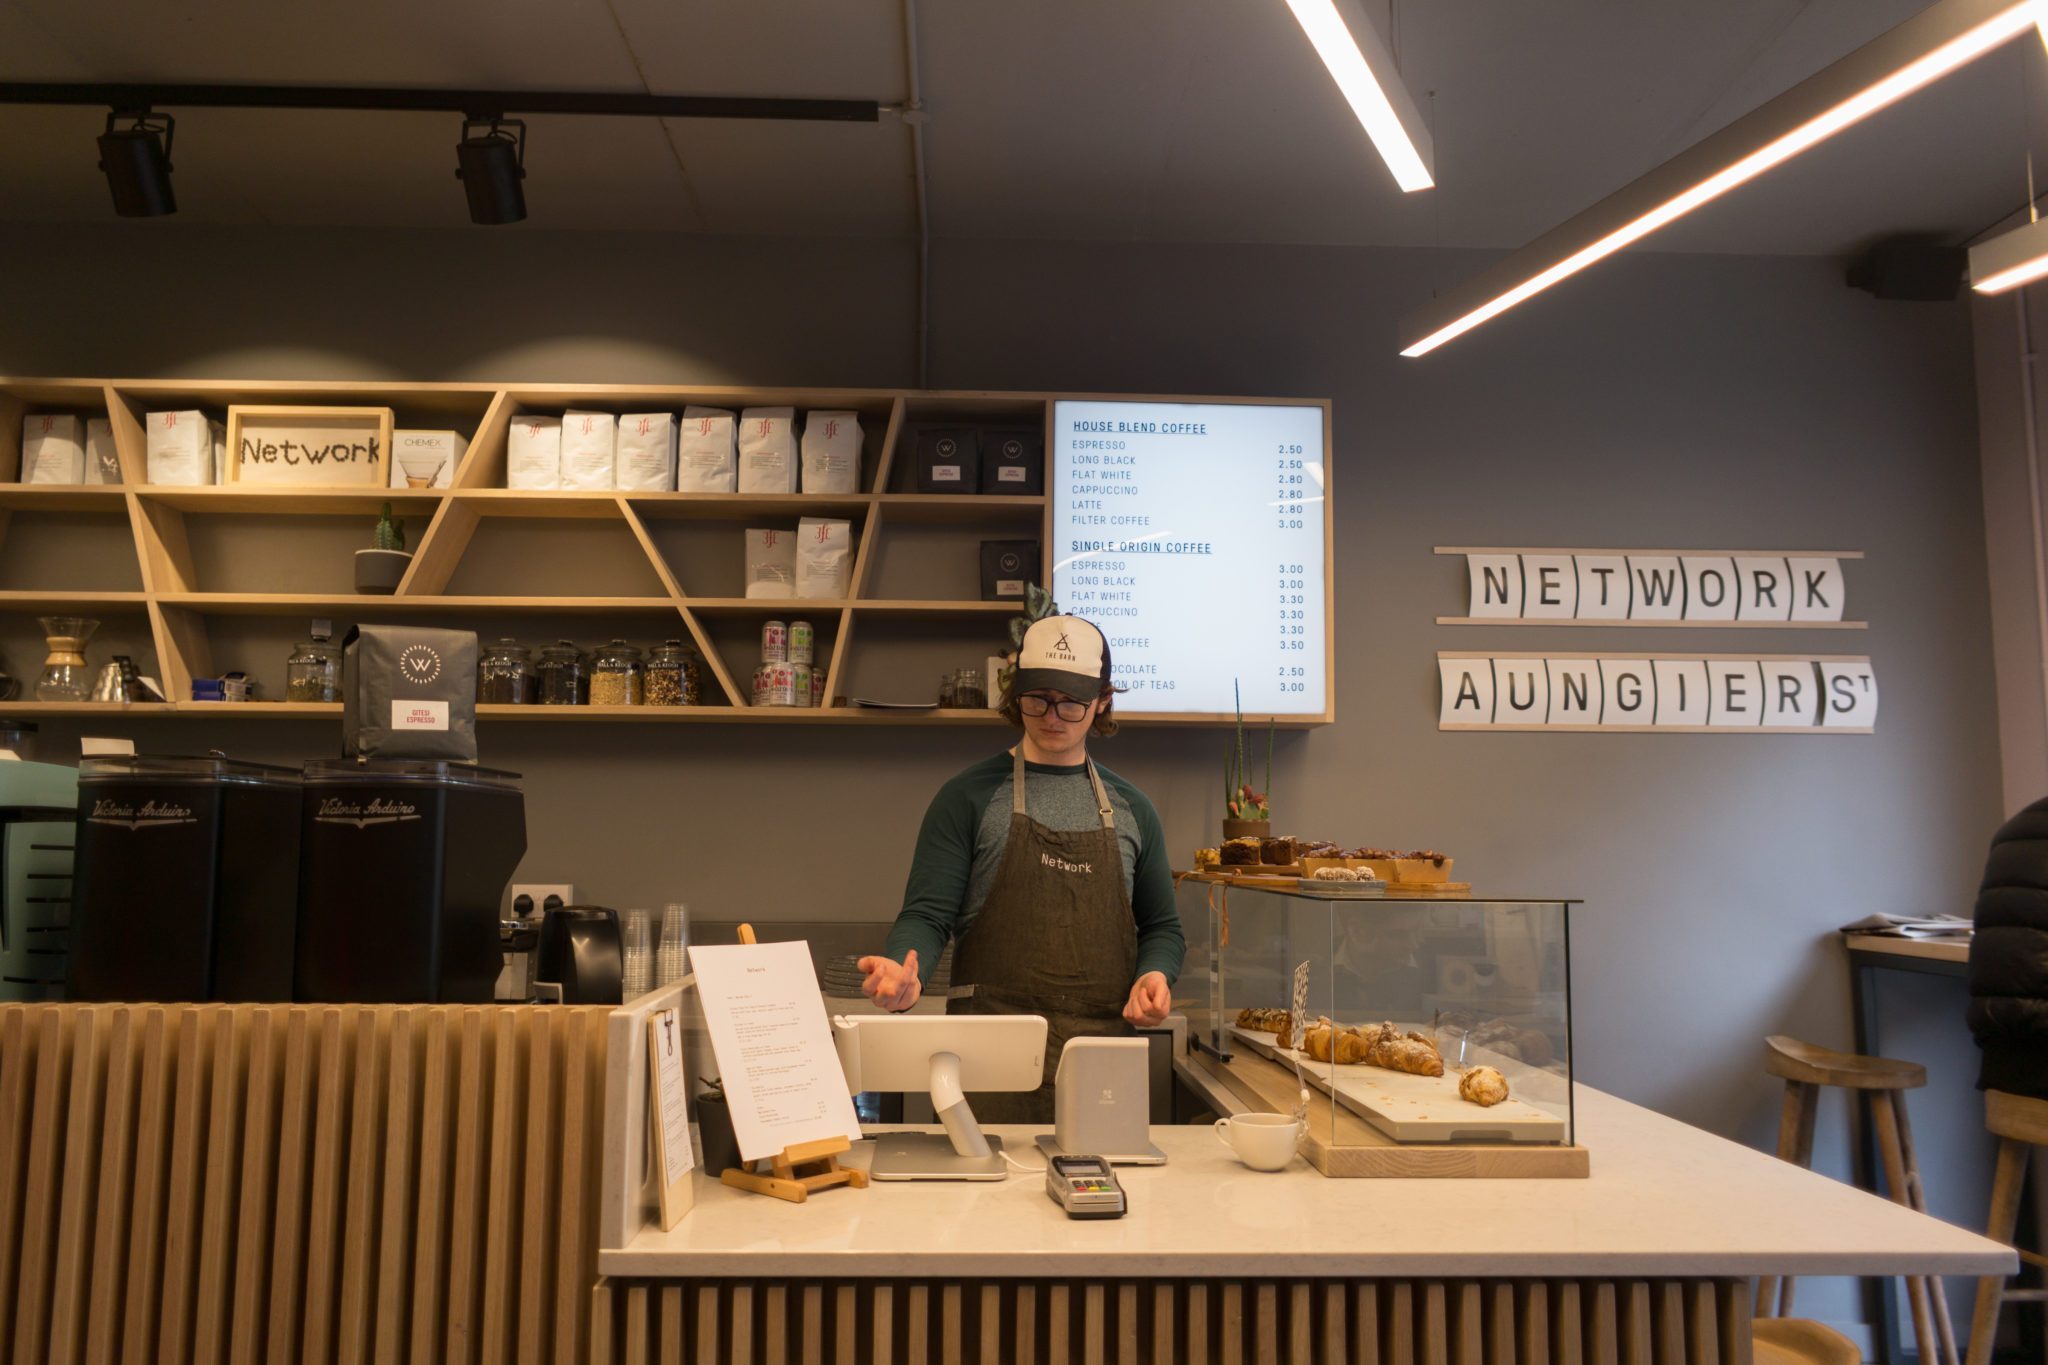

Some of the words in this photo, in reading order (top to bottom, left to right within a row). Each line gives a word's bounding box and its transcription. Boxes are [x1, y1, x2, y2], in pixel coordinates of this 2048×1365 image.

[1073, 421, 1113, 432] HOUSE
[1119, 422, 1156, 433] BLEND
[1162, 423, 1207, 434] COFFEE
[404, 438, 441, 447] CHEMEX
[1072, 440, 1126, 450] ESPRESSO
[240, 437, 379, 465] Network
[1278, 444, 1302, 454] 2.50
[1072, 455, 1099, 465] LONG
[1104, 456, 1136, 465] BLACK
[1278, 460, 1303, 469] 2.50
[1072, 470, 1096, 479] FLAT
[1101, 471, 1132, 480] WHITE
[1278, 475, 1303, 484] 2.80
[1072, 485, 1138, 495] CAPPUCCINO
[1278, 490, 1303, 499] 2.80
[1072, 500, 1102, 510] LATTE
[1278, 505, 1303, 514] 2.80
[1072, 516, 1106, 525] FILTER
[1110, 516, 1150, 526] COFFEE
[1278, 520, 1303, 529] 3.00
[1072, 541, 1115, 552] SINGLE
[1120, 542, 1161, 552] ORIGIN
[1166, 543, 1212, 554] COFFEE
[1072, 561, 1126, 571] ESPRESSO
[1279, 565, 1304, 574] 3.00
[1072, 576, 1099, 586] LONG
[1104, 577, 1136, 586] BLACK
[1279, 580, 1304, 589] 3.00
[1482, 566, 1830, 609] NETWORK
[1072, 591, 1096, 600] FLAT
[1100, 592, 1132, 601] WHITE
[1280, 595, 1304, 604] 3.30
[1072, 607, 1138, 616] CAPPUCCINO
[1280, 610, 1304, 619] 3.30
[1280, 626, 1304, 634] 3.30
[1110, 638, 1150, 648] COFFEE
[1280, 641, 1304, 650] 3.50
[1111, 665, 1157, 674] OCOLATE
[1280, 667, 1304, 676] 2.50
[1133, 681, 1146, 690] OF
[1151, 681, 1175, 690] TEAS
[1280, 683, 1305, 692] 3.00
[1454, 671, 1802, 714] AUNGIER
[407, 716, 436, 724] ESPRESSO
[92, 799, 134, 816] Victoria
[319, 798, 361, 815] Victoria
[363, 798, 416, 815] Arduino
[1041, 853, 1093, 873] Network
